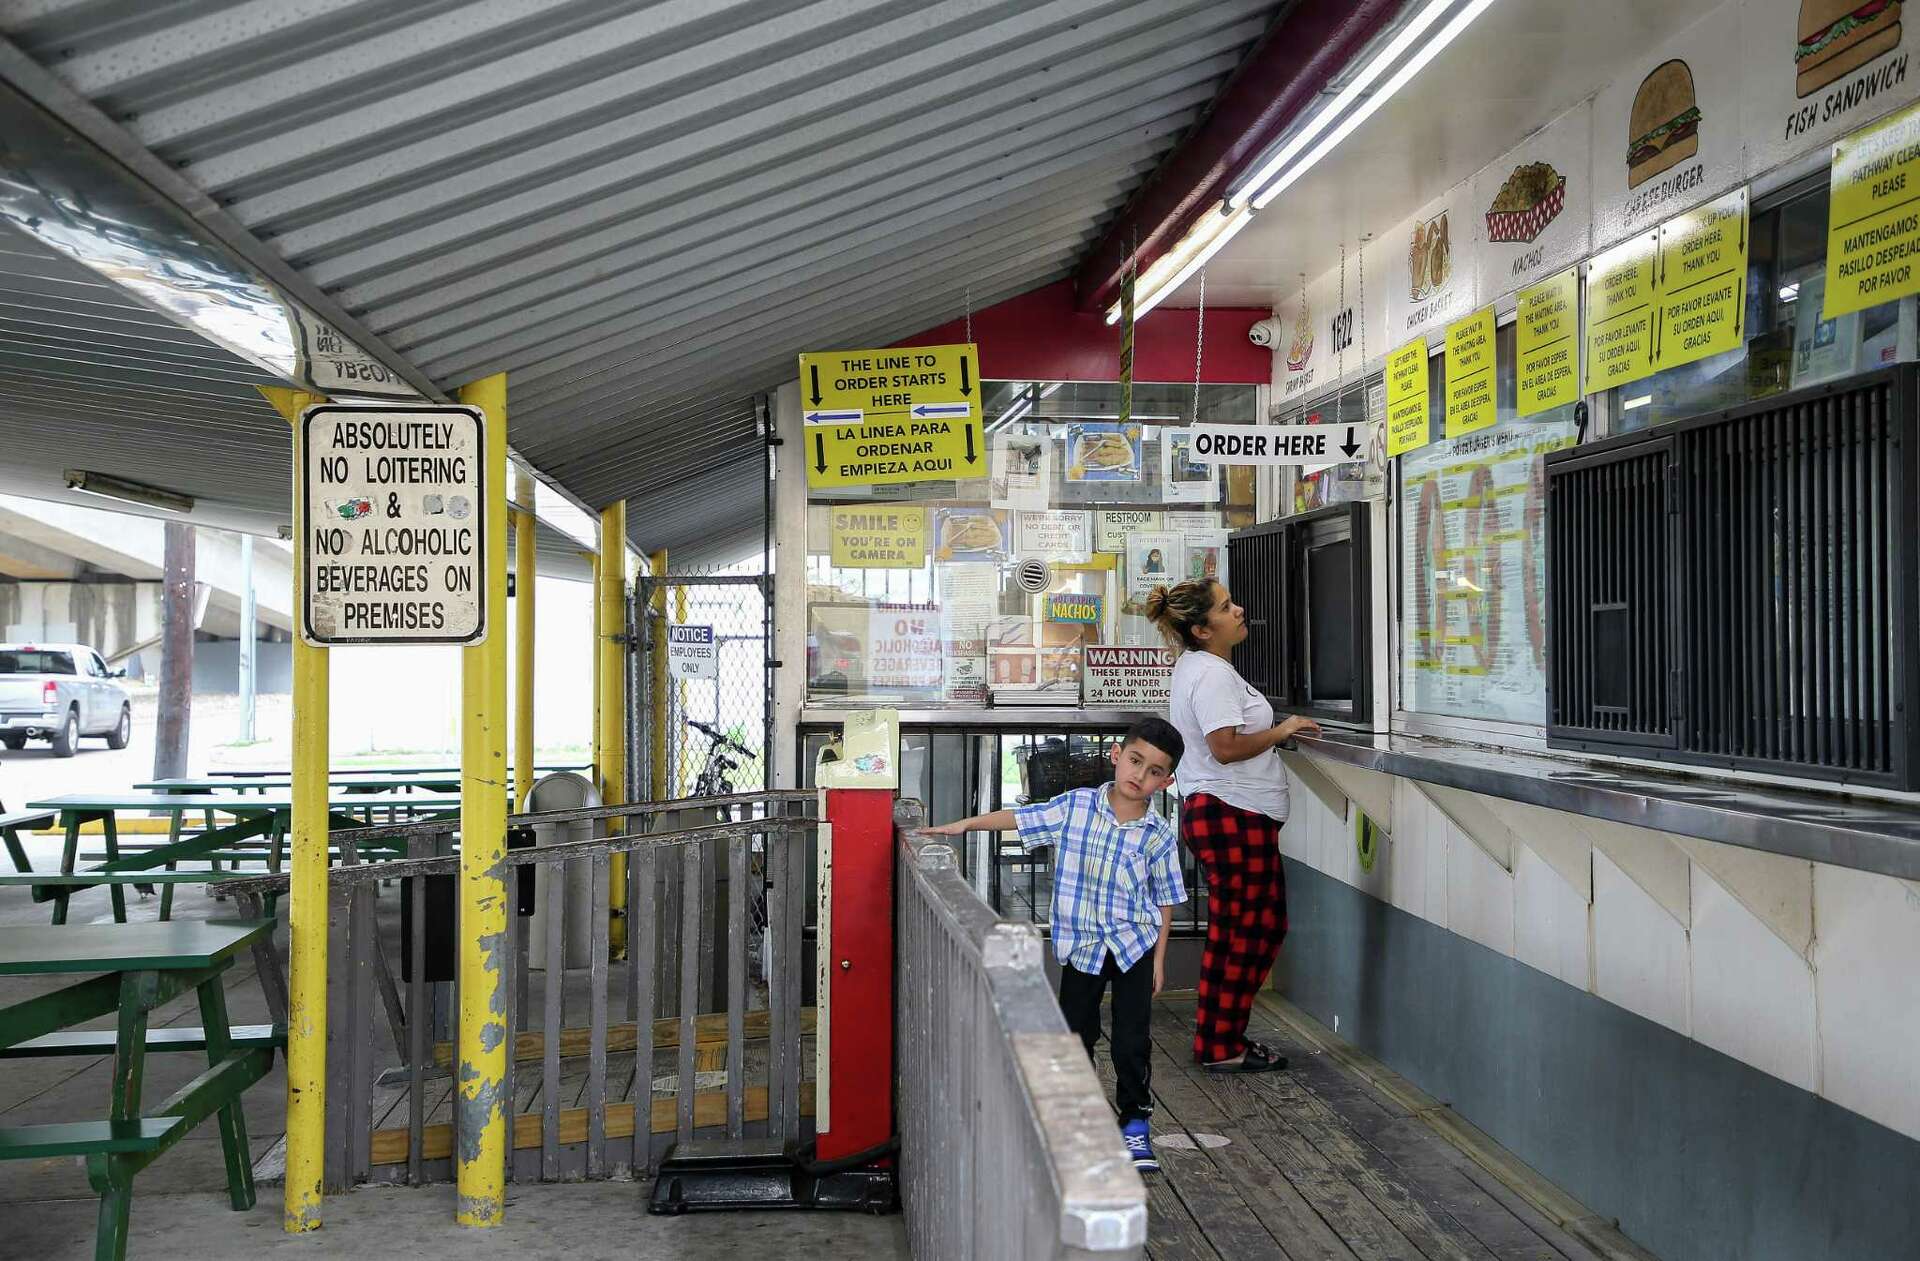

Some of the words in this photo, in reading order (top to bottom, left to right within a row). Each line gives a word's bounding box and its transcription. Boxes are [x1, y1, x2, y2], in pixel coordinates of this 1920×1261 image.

[1786, 103, 1818, 140] FISH
[1823, 53, 1909, 123] SANDWICH
[1852, 153, 1894, 184] PATHWAY
[1872, 173, 1906, 200] PLEASE
[1707, 212, 1716, 226] UP
[1844, 214, 1918, 254] MANTENGAMOS
[1682, 237, 1702, 255] ORDER
[1512, 245, 1544, 277] NACHOS
[1683, 255, 1705, 273] THANK
[1706, 248, 1720, 263] YOU
[1839, 255, 1873, 279] PASILLO
[1604, 274, 1622, 290] ORDER
[1859, 276, 1877, 296] POR
[1880, 266, 1911, 288] FAVOR
[1529, 293, 1544, 306] PLEASE
[1606, 290, 1624, 306] THANK
[1625, 284, 1636, 298] YOU
[1667, 306, 1679, 319] POR
[1681, 297, 1701, 314] FAVOR
[1702, 286, 1732, 306] LEVANTE
[1525, 313, 1533, 324] THE
[1534, 305, 1553, 320] WAITING
[1533, 323, 1548, 336] THANK
[1549, 318, 1559, 329] YOU
[1594, 336, 1604, 347] POR
[1605, 329, 1621, 343] FAVOR
[1622, 319, 1646, 336] LEVANTE
[1672, 323, 1681, 335] SU
[1682, 314, 1704, 331] ORDEN
[1683, 331, 1711, 350] GRACIAS
[1526, 362, 1535, 372] POR
[1535, 356, 1550, 369] FAVOR
[1551, 349, 1567, 363] ESPERE
[1599, 352, 1605, 362] SU
[1606, 344, 1624, 359] ORDEN
[842, 359, 871, 372] THE
[877, 357, 910, 370] LINE
[915, 355, 936, 367] TO
[1607, 360, 1629, 375] GRACIAS
[835, 376, 887, 391] ORDER
[893, 373, 946, 387] STARTS
[1522, 380, 1528, 389] EN
[1529, 379, 1533, 387] EL
[1535, 374, 1546, 385] AREA
[1547, 371, 1553, 380] DE
[872, 394, 912, 407] HERE
[1537, 386, 1556, 400] GRACIAS
[333, 422, 453, 449] ABSOLUTELY
[837, 428, 856, 440] LA
[861, 425, 906, 439] LINEA
[911, 423, 950, 435] PARA
[857, 442, 933, 457] ORDENAR
[1196, 434, 1267, 455] ORDER
[1275, 435, 1326, 455] HERE
[321, 457, 348, 484] NO
[367, 457, 465, 484] LOITERING
[840, 462, 908, 477] EMPIEZA
[913, 459, 952, 472] AQUI
[387, 492, 401, 518] &
[835, 515, 898, 531] SMILE
[1106, 512, 1151, 522] RESTROOM
[316, 529, 343, 555] NO
[361, 528, 471, 555] ALCOHOLIC
[842, 537, 890, 547] YOU'RE
[896, 538, 915, 547] ON
[850, 550, 905, 560] CAMERA
[317, 566, 428, 592] BEVERAGES
[445, 566, 471, 592] ON
[345, 602, 444, 629] PREMISES
[1052, 604, 1096, 620] NACHOS
[671, 628, 708, 641] NOTICE
[671, 647, 711, 658] EMPLOYEES
[959, 641, 973, 650] NO
[1088, 650, 1174, 665] WARNING
[682, 663, 699, 673] ONLY
